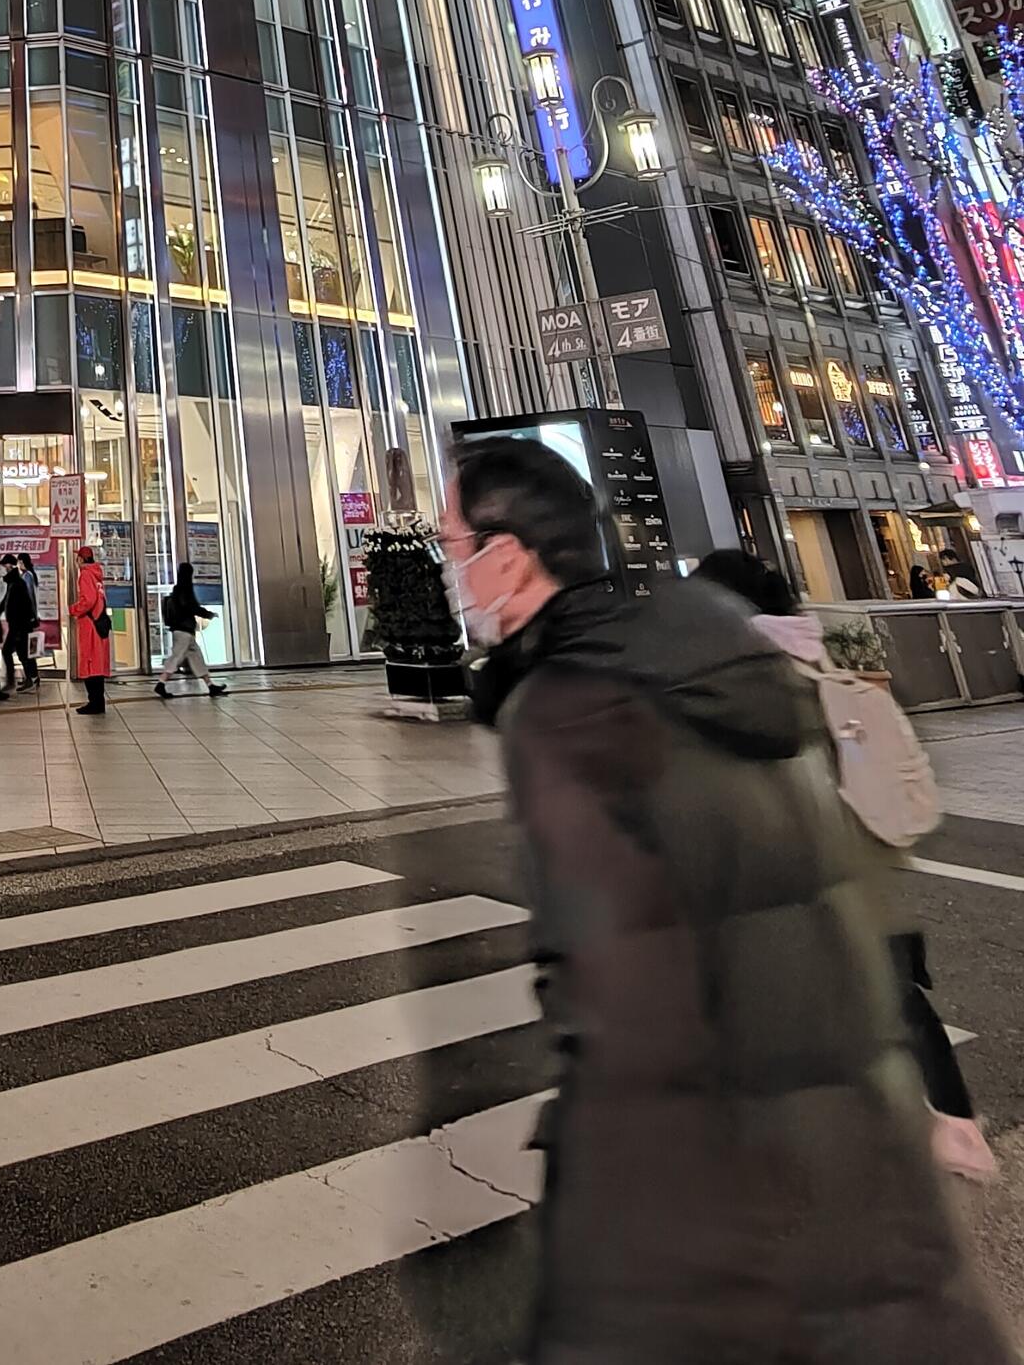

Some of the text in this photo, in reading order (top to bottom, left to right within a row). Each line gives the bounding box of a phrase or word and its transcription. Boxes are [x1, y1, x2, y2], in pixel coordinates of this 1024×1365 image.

[610, 297, 650, 320] モア
[541, 310, 583, 333] MOA
[616, 324, 660, 349] 4番街
